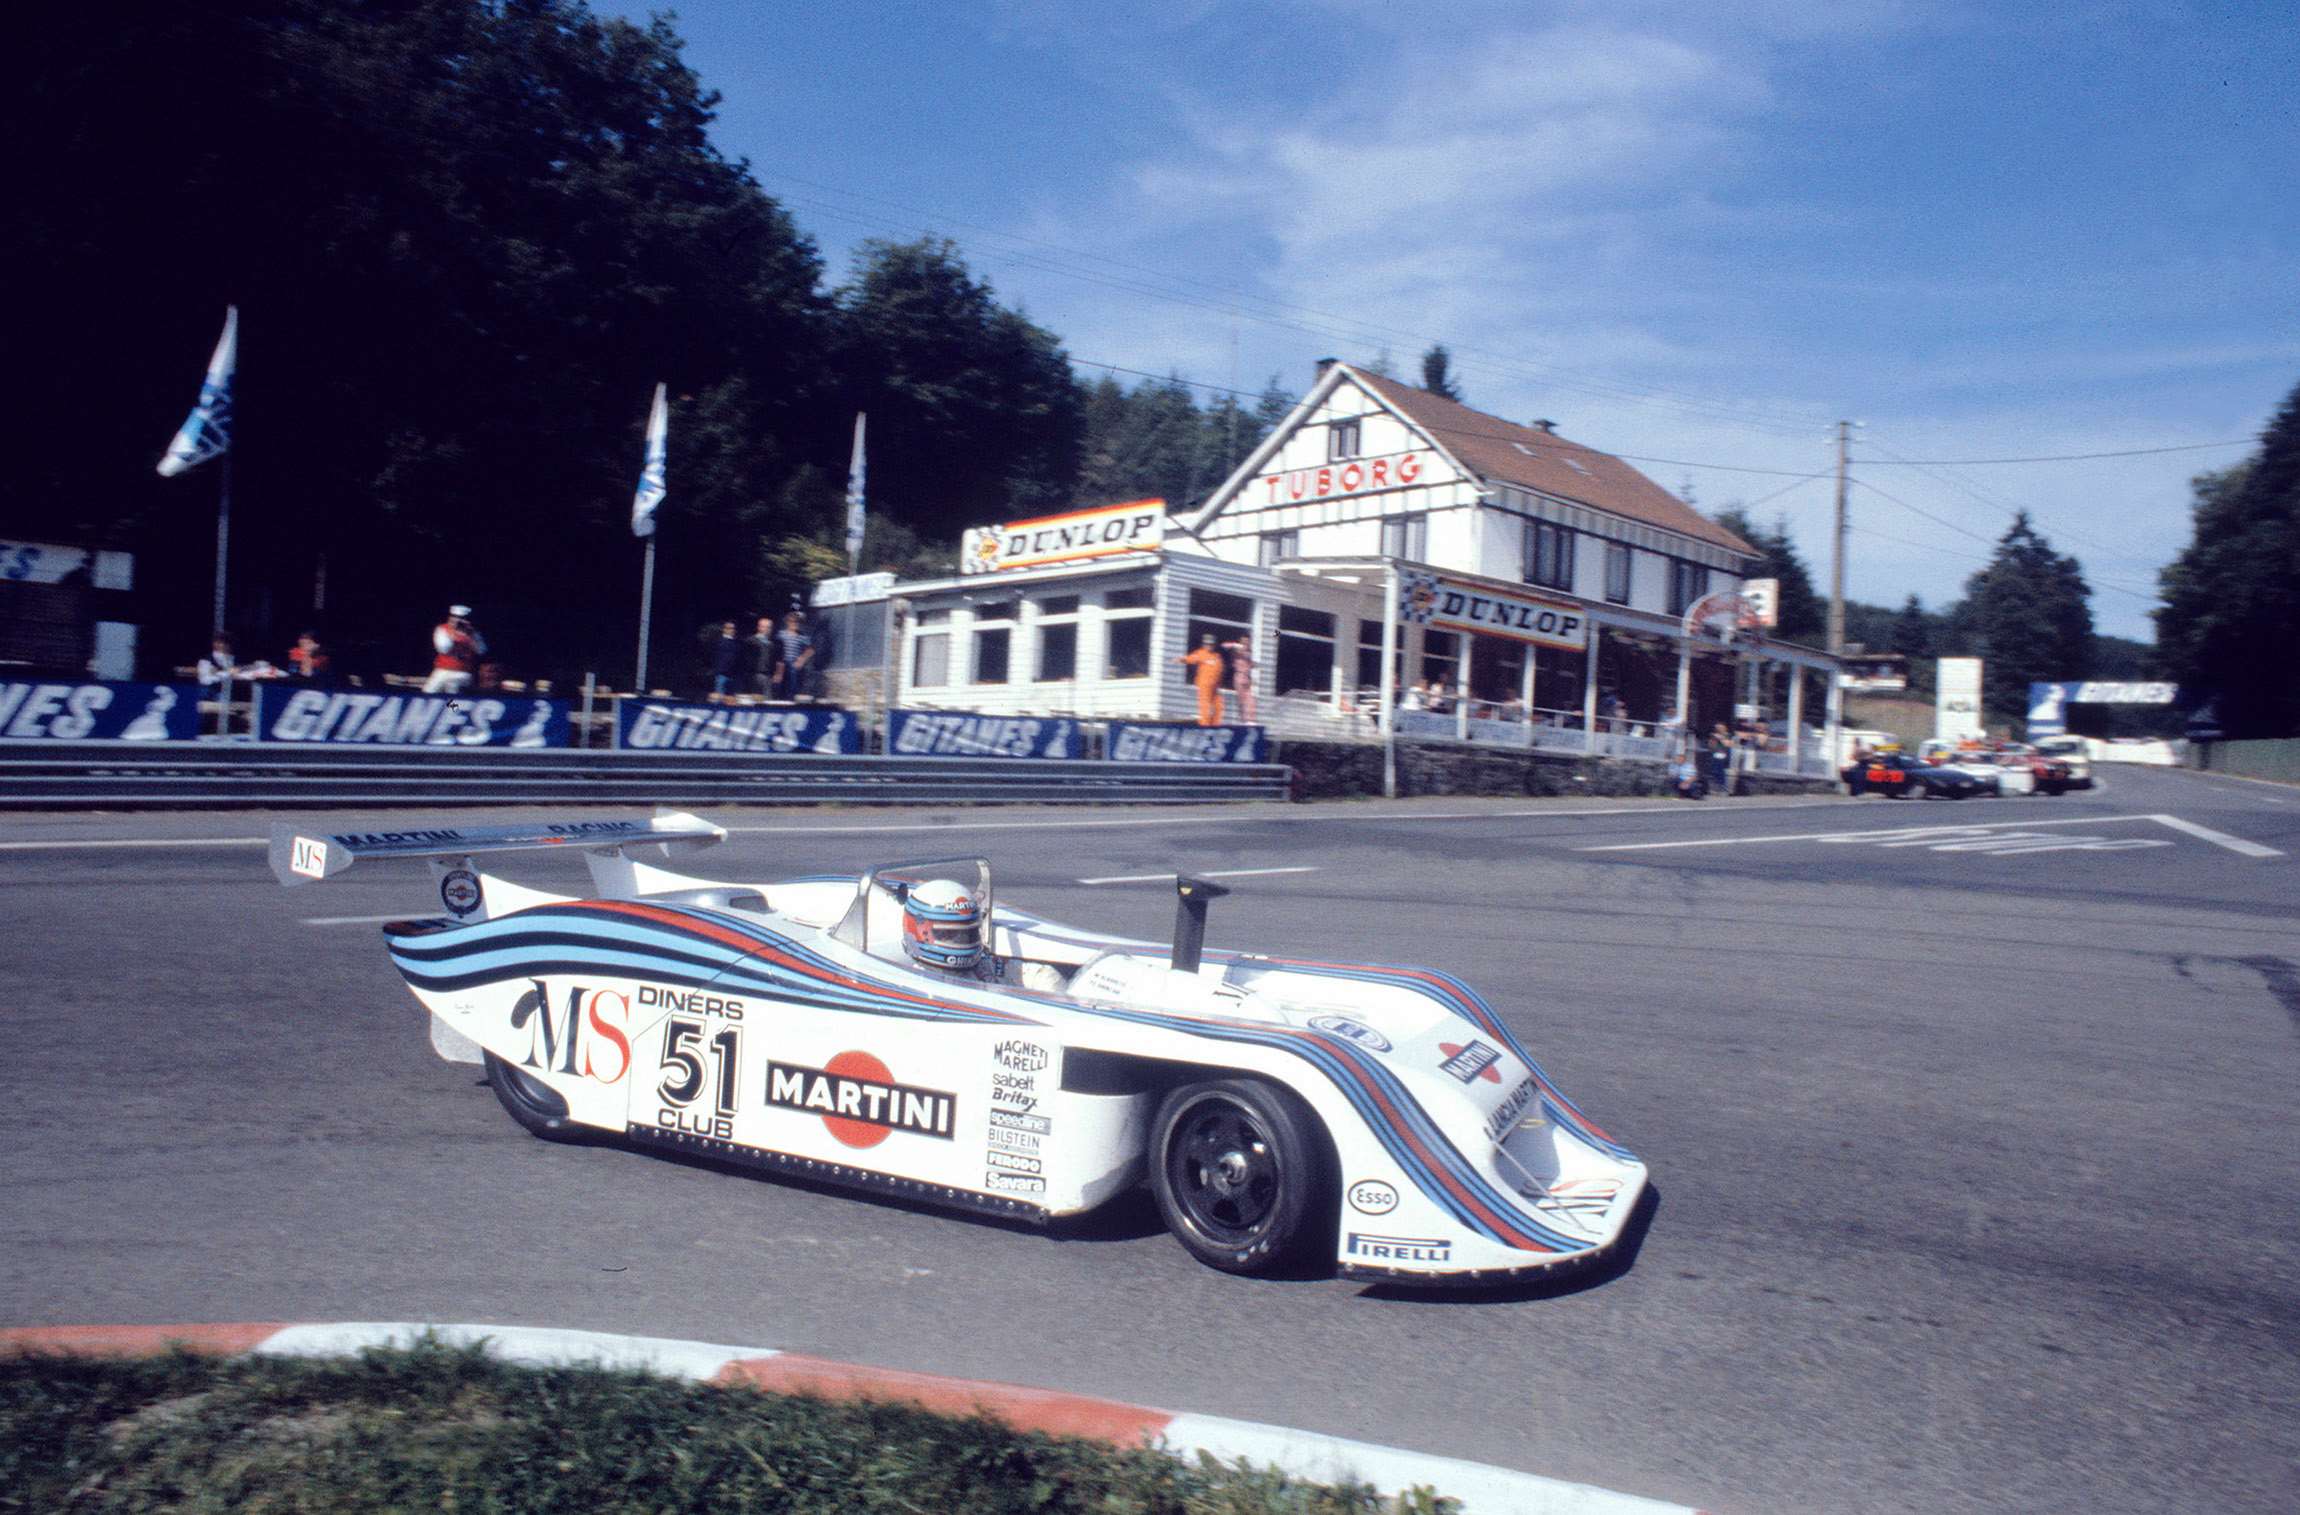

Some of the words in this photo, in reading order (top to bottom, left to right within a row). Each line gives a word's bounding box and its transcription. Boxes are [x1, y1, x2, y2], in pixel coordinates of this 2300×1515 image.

[1265, 454, 1421, 503] TUBORG
[1006, 515, 1154, 556] DUNLOP
[1441, 592, 1579, 636] DUNLOP
[272, 690, 506, 745] GITANES
[628, 705, 809, 751] GITANES
[896, 714, 1041, 757] GITANES
[1113, 726, 1234, 761] GITANES
[333, 829, 465, 847] MARTINI
[547, 821, 637, 835] RACING
[295, 841, 324, 871] MS
[638, 986, 744, 1021] DINERS
[511, 977, 631, 1084] MS
[657, 1014, 744, 1119] 51
[1444, 1042, 1497, 1080] MARTINI
[772, 1068, 949, 1132] MARTINI
[992, 1087, 1038, 1112] Britax
[657, 1107, 734, 1140] CLUB
[988, 1128, 1040, 1148] BILSTEIN
[1347, 1232, 1451, 1261] PIRELLI
